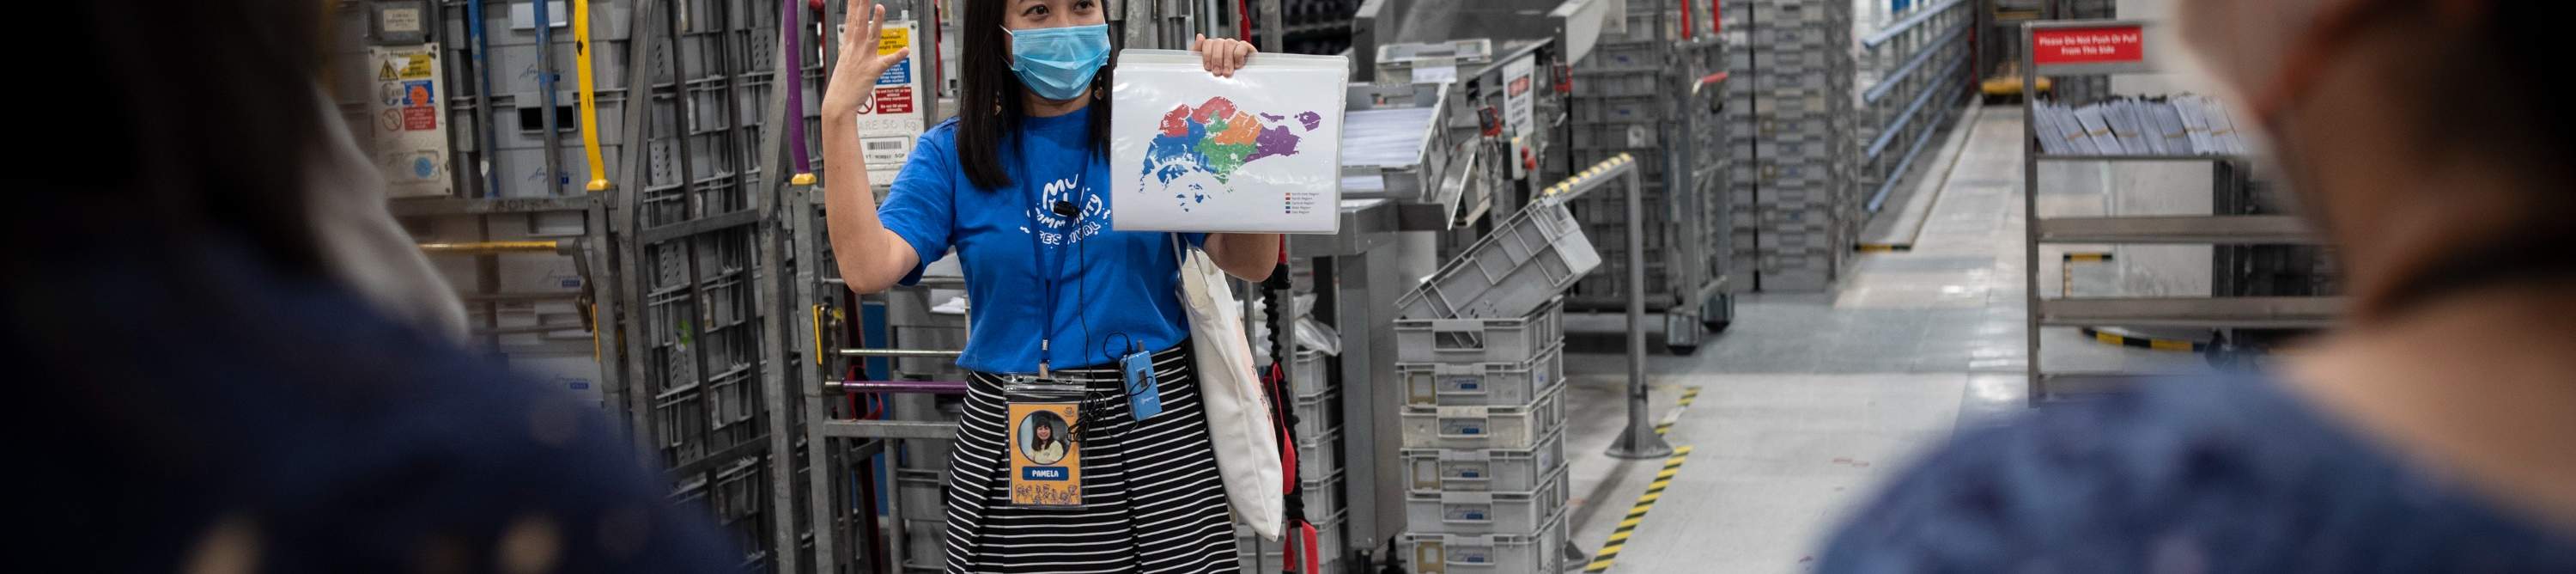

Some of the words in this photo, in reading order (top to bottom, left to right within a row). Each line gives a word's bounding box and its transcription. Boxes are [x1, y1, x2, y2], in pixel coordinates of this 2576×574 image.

[2038, 36, 2063, 46] Please
[2064, 35, 2075, 45] Do
[2076, 34, 2091, 45] Not
[2092, 34, 2111, 44] Push
[2111, 34, 2121, 43] Or
[2122, 34, 2136, 43] Pull
[2061, 46, 2081, 55] From
[2081, 46, 2098, 55] This
[2099, 45, 2115, 54] Side
